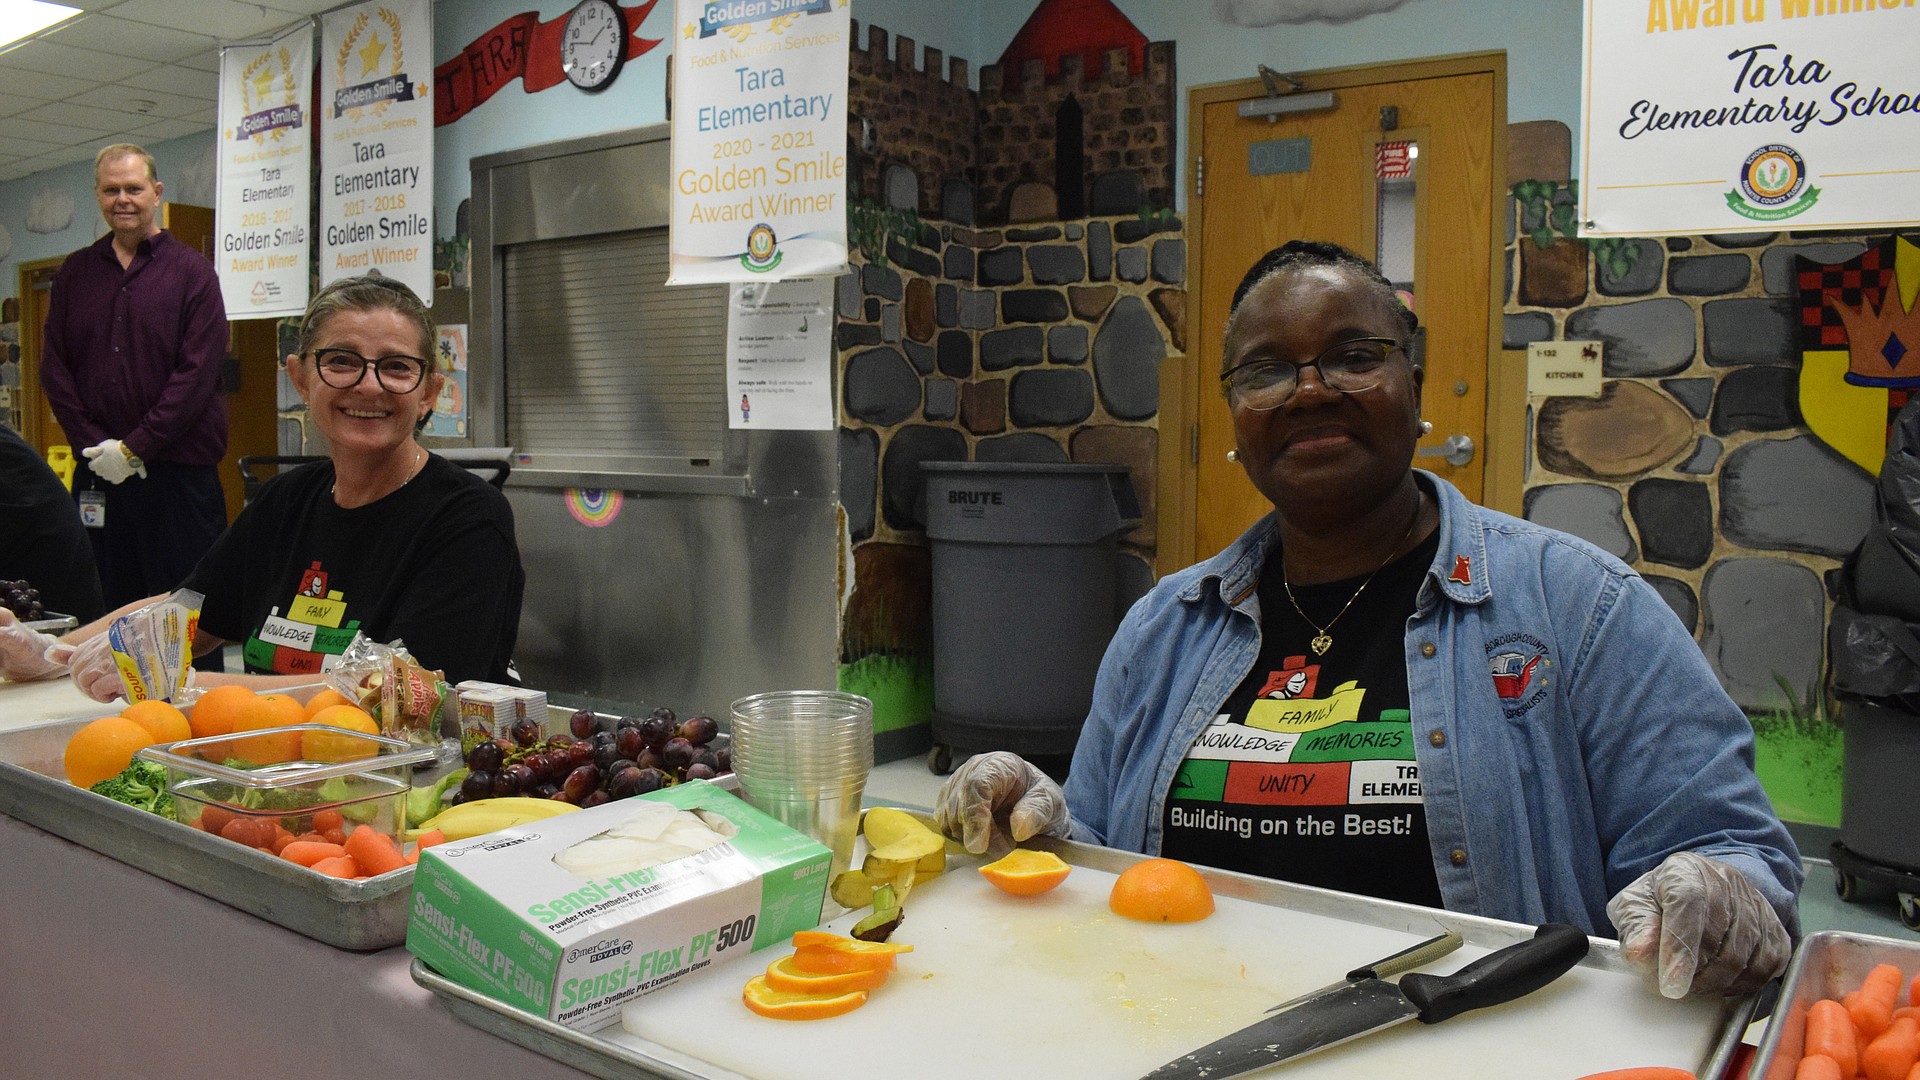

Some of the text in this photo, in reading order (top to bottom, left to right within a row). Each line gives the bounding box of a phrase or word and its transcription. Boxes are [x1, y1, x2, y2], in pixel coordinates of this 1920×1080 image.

[579, 14, 586, 26] 11
[587, 7, 596, 20] 12
[606, 17, 613, 29] 2
[706, 1, 766, 25] Golden
[571, 27, 580, 39] 10
[610, 32, 617, 44] 3
[569, 43, 575, 55] 9
[606, 49, 613, 60] 4
[691, 53, 717, 68] Food
[720, 50, 727, 62] &
[785, 31, 840, 50] Services
[434, 26, 527, 115] TARA
[572, 58, 578, 69] 8
[580, 67, 587, 78] 7
[590, 68, 596, 79] 6
[600, 61, 606, 73] 5
[1727, 43, 1832, 94] Tara
[735, 67, 785, 92] Tara
[337, 79, 404, 107] Golden Smile
[243, 108, 298, 132] Golden Smile
[381, 117, 417, 129] Services
[698, 93, 833, 132] Elementary
[1618, 95, 1821, 140] Elementary
[353, 142, 385, 163] Tara
[713, 138, 752, 159] 2020
[771, 131, 815, 151] 2021
[1746, 148, 1767, 165] SCHOOL
[1768, 145, 1795, 156] DISTRICT
[1793, 155, 1802, 163] OF
[261, 168, 281, 182] Tara
[335, 166, 420, 196] Elementary
[678, 151, 845, 196] Golden Smile
[243, 185, 294, 203] Elementary
[1760, 197, 1786, 205] COUNTY
[1786, 177, 1804, 198] FLORIDA
[343, 199, 365, 218] 2017
[374, 193, 406, 212] 2018
[689, 192, 836, 224] Award Winner
[1732, 202, 1748, 213] Food
[1786, 200, 1812, 216] Services
[241, 211, 266, 227] 2016
[273, 207, 293, 224] 2017
[224, 224, 305, 252] Golden Smile
[327, 213, 428, 247] Golden Smile
[231, 254, 298, 273] Award Winner
[336, 246, 418, 269] Award Winner
[948, 490, 1003, 506] BRUTE
[1521, 633, 1550, 655] COUNTY
[126, 671, 147, 701] SOUP
[408, 669, 425, 716] Apples
[1279, 699, 1340, 724] FAMILY
[1305, 731, 1405, 751] MEMORIES
[1258, 773, 1317, 795] UNITY
[1171, 807, 1412, 838] Building on the Best!
[548, 906, 597, 932] Powder-Free
[594, 894, 628, 912] Synthetic
[627, 888, 643, 902] PVC
[414, 891, 490, 968] Sensi-Flex
[556, 923, 574, 935] Medical
[574, 917, 589, 928] Grade
[533, 939, 553, 960] Large
[591, 947, 620, 962] ROYAL
[559, 945, 685, 1010] Sensi-Flex
[557, 999, 603, 1022] Powder-Free
[604, 986, 635, 1005] Synthetic
[636, 981, 651, 993] PVC
[651, 967, 690, 988] Examination
[690, 958, 711, 973] Gloves
